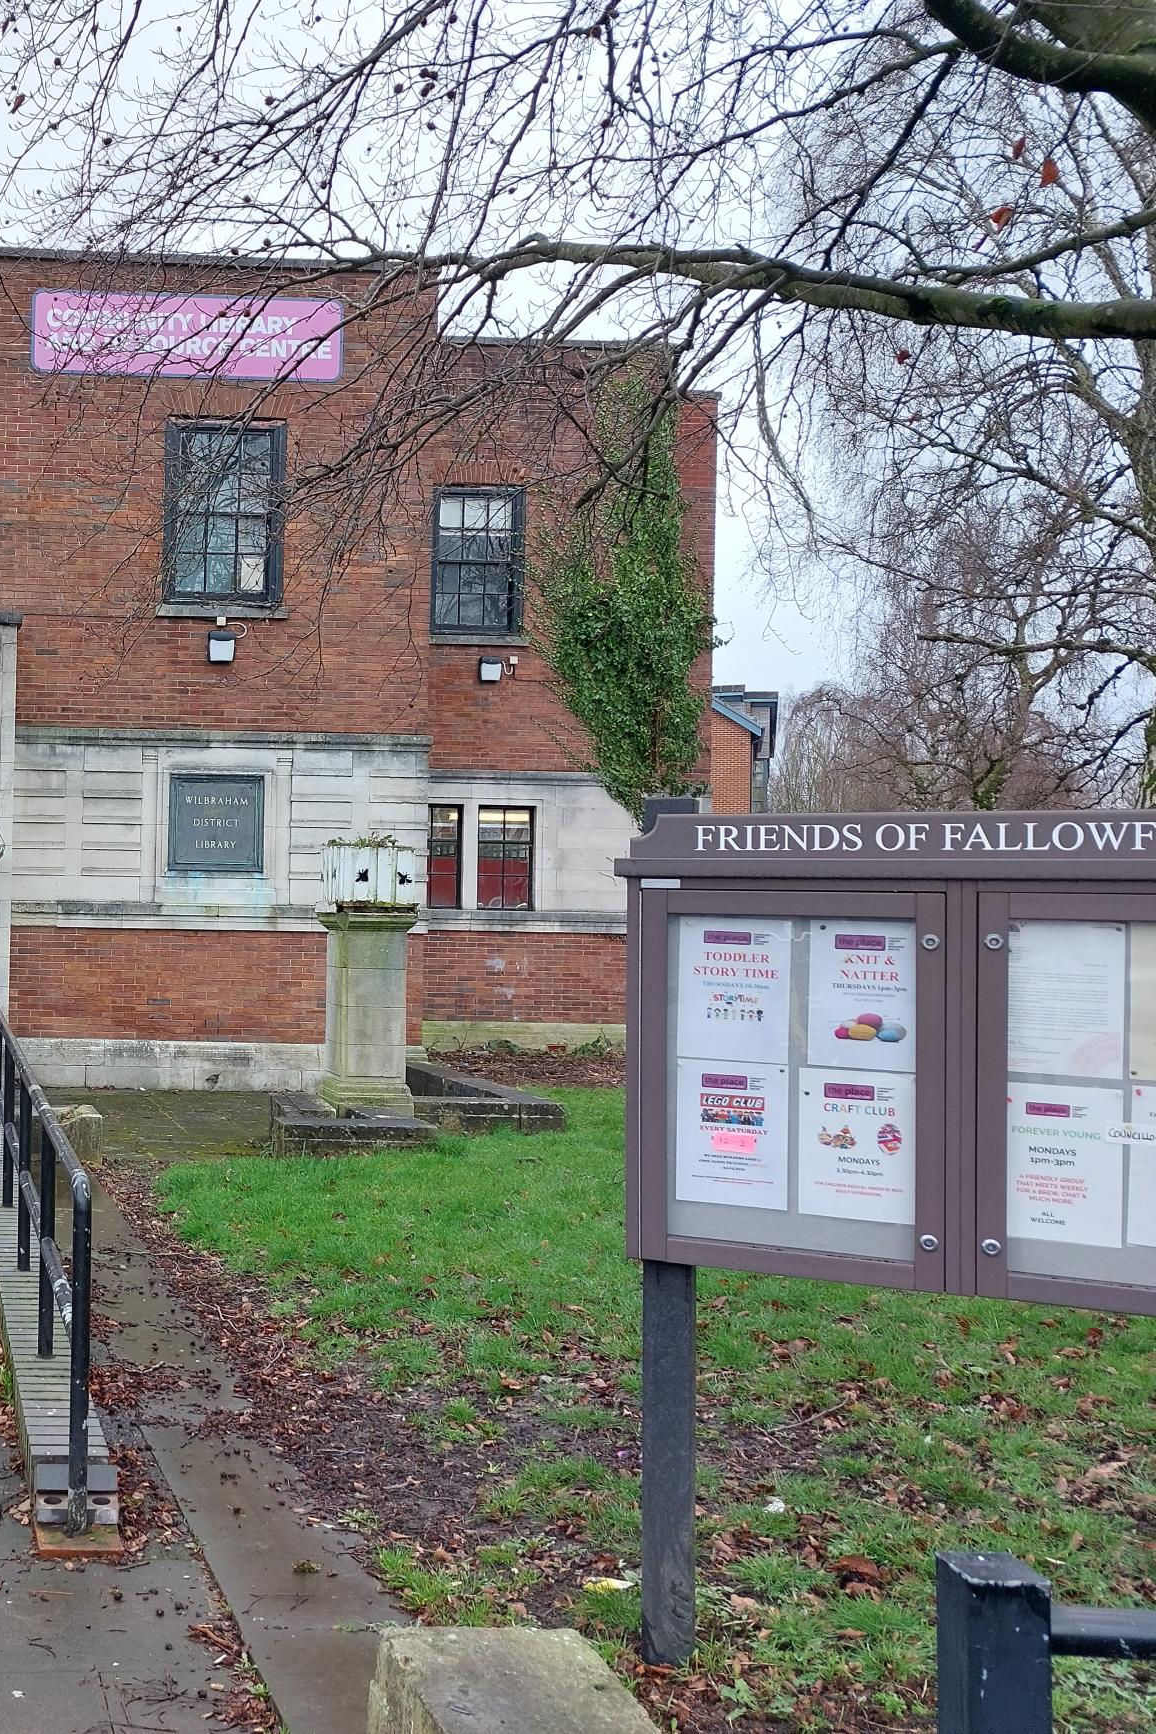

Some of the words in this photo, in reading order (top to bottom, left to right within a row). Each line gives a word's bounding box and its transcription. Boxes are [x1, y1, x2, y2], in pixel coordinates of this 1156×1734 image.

[200, 314, 299, 336] LIBRARY
[240, 338, 332, 360] CENTRE
[185, 795, 249, 806] WILBRAHAM
[193, 818, 240, 828] DISTRICT
[693, 822, 863, 852] FRIENDS
[875, 822, 929, 852] OF
[943, 821, 1156, 851] FALLOWF
[195, 839, 237, 849] LIBRARY
[704, 951, 770, 963] TODDLER
[844, 954, 880, 965] KNIT
[884, 955, 895, 966] &
[693, 965, 739, 977] STORY
[742, 968, 779, 979] TIME
[840, 969, 900, 982] NATTER
[832, 982, 877, 990] THURSDAYS
[702, 1095, 730, 1106] LEGO
[731, 1097, 764, 1108] CLUB
[824, 1102, 861, 1114] CRAFT
[864, 1105, 896, 1117] CLUB
[700, 1124, 725, 1132] EVERY
[726, 1126, 769, 1136] SATURDAY
[1011, 1125, 1060, 1137] FOREVER
[1062, 1129, 1102, 1141] YOUNG
[1028, 1145, 1077, 1157] MONDAYS
[837, 1156, 881, 1166] MONDAYS
[1029, 1156, 1075, 1168] 1pm-3pm
[1025, 1174, 1059, 1182] FRIENDLY
[1059, 1184, 1089, 1192] WEEKLY
[1029, 1195, 1051, 1203] MUCH
[1030, 1217, 1066, 1226] WELCOME
